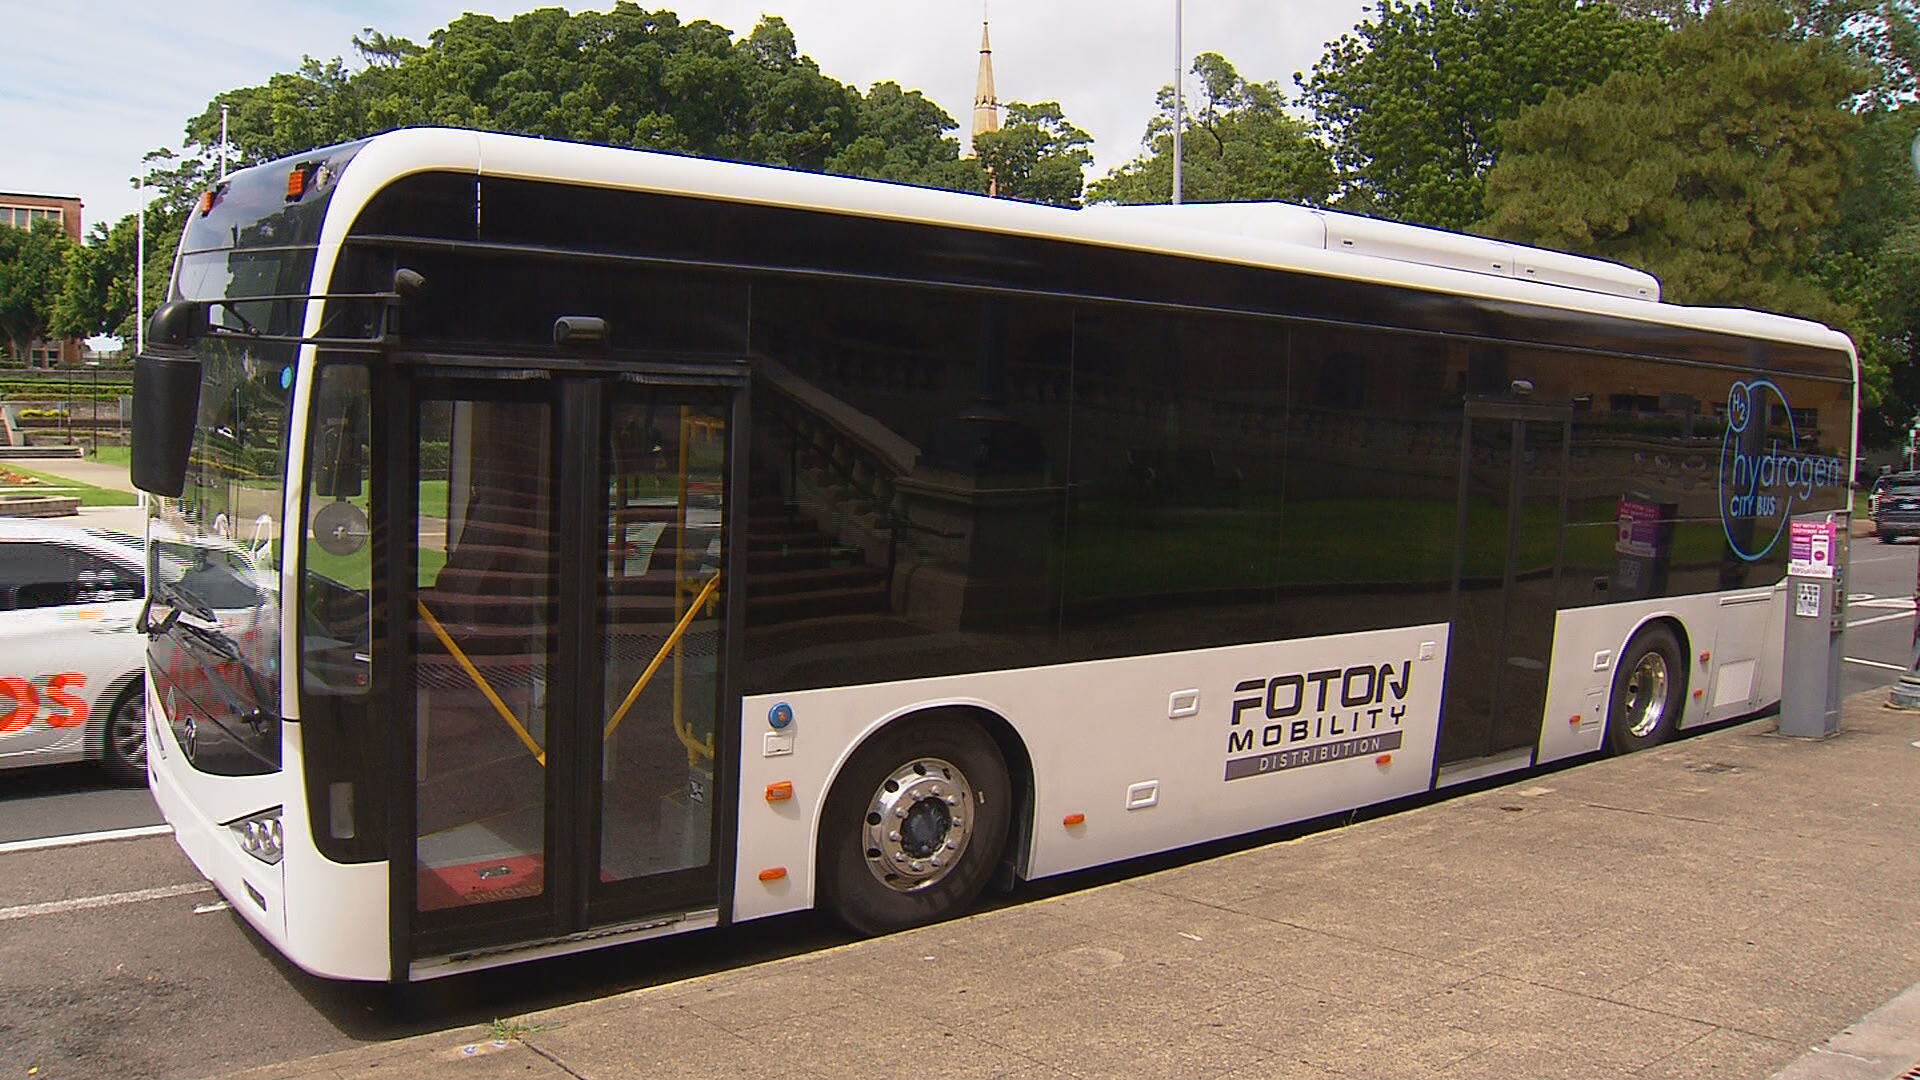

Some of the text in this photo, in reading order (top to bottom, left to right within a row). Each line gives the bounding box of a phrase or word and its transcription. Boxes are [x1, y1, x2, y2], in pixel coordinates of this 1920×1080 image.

[1732, 436, 1841, 500] hydrogen
[1730, 495, 1776, 517] CITY BUS
[1231, 660, 1411, 726] FOTON
[1228, 704, 1406, 752] MOBILITY
[1259, 737, 1381, 771] DISTRIBUTION
